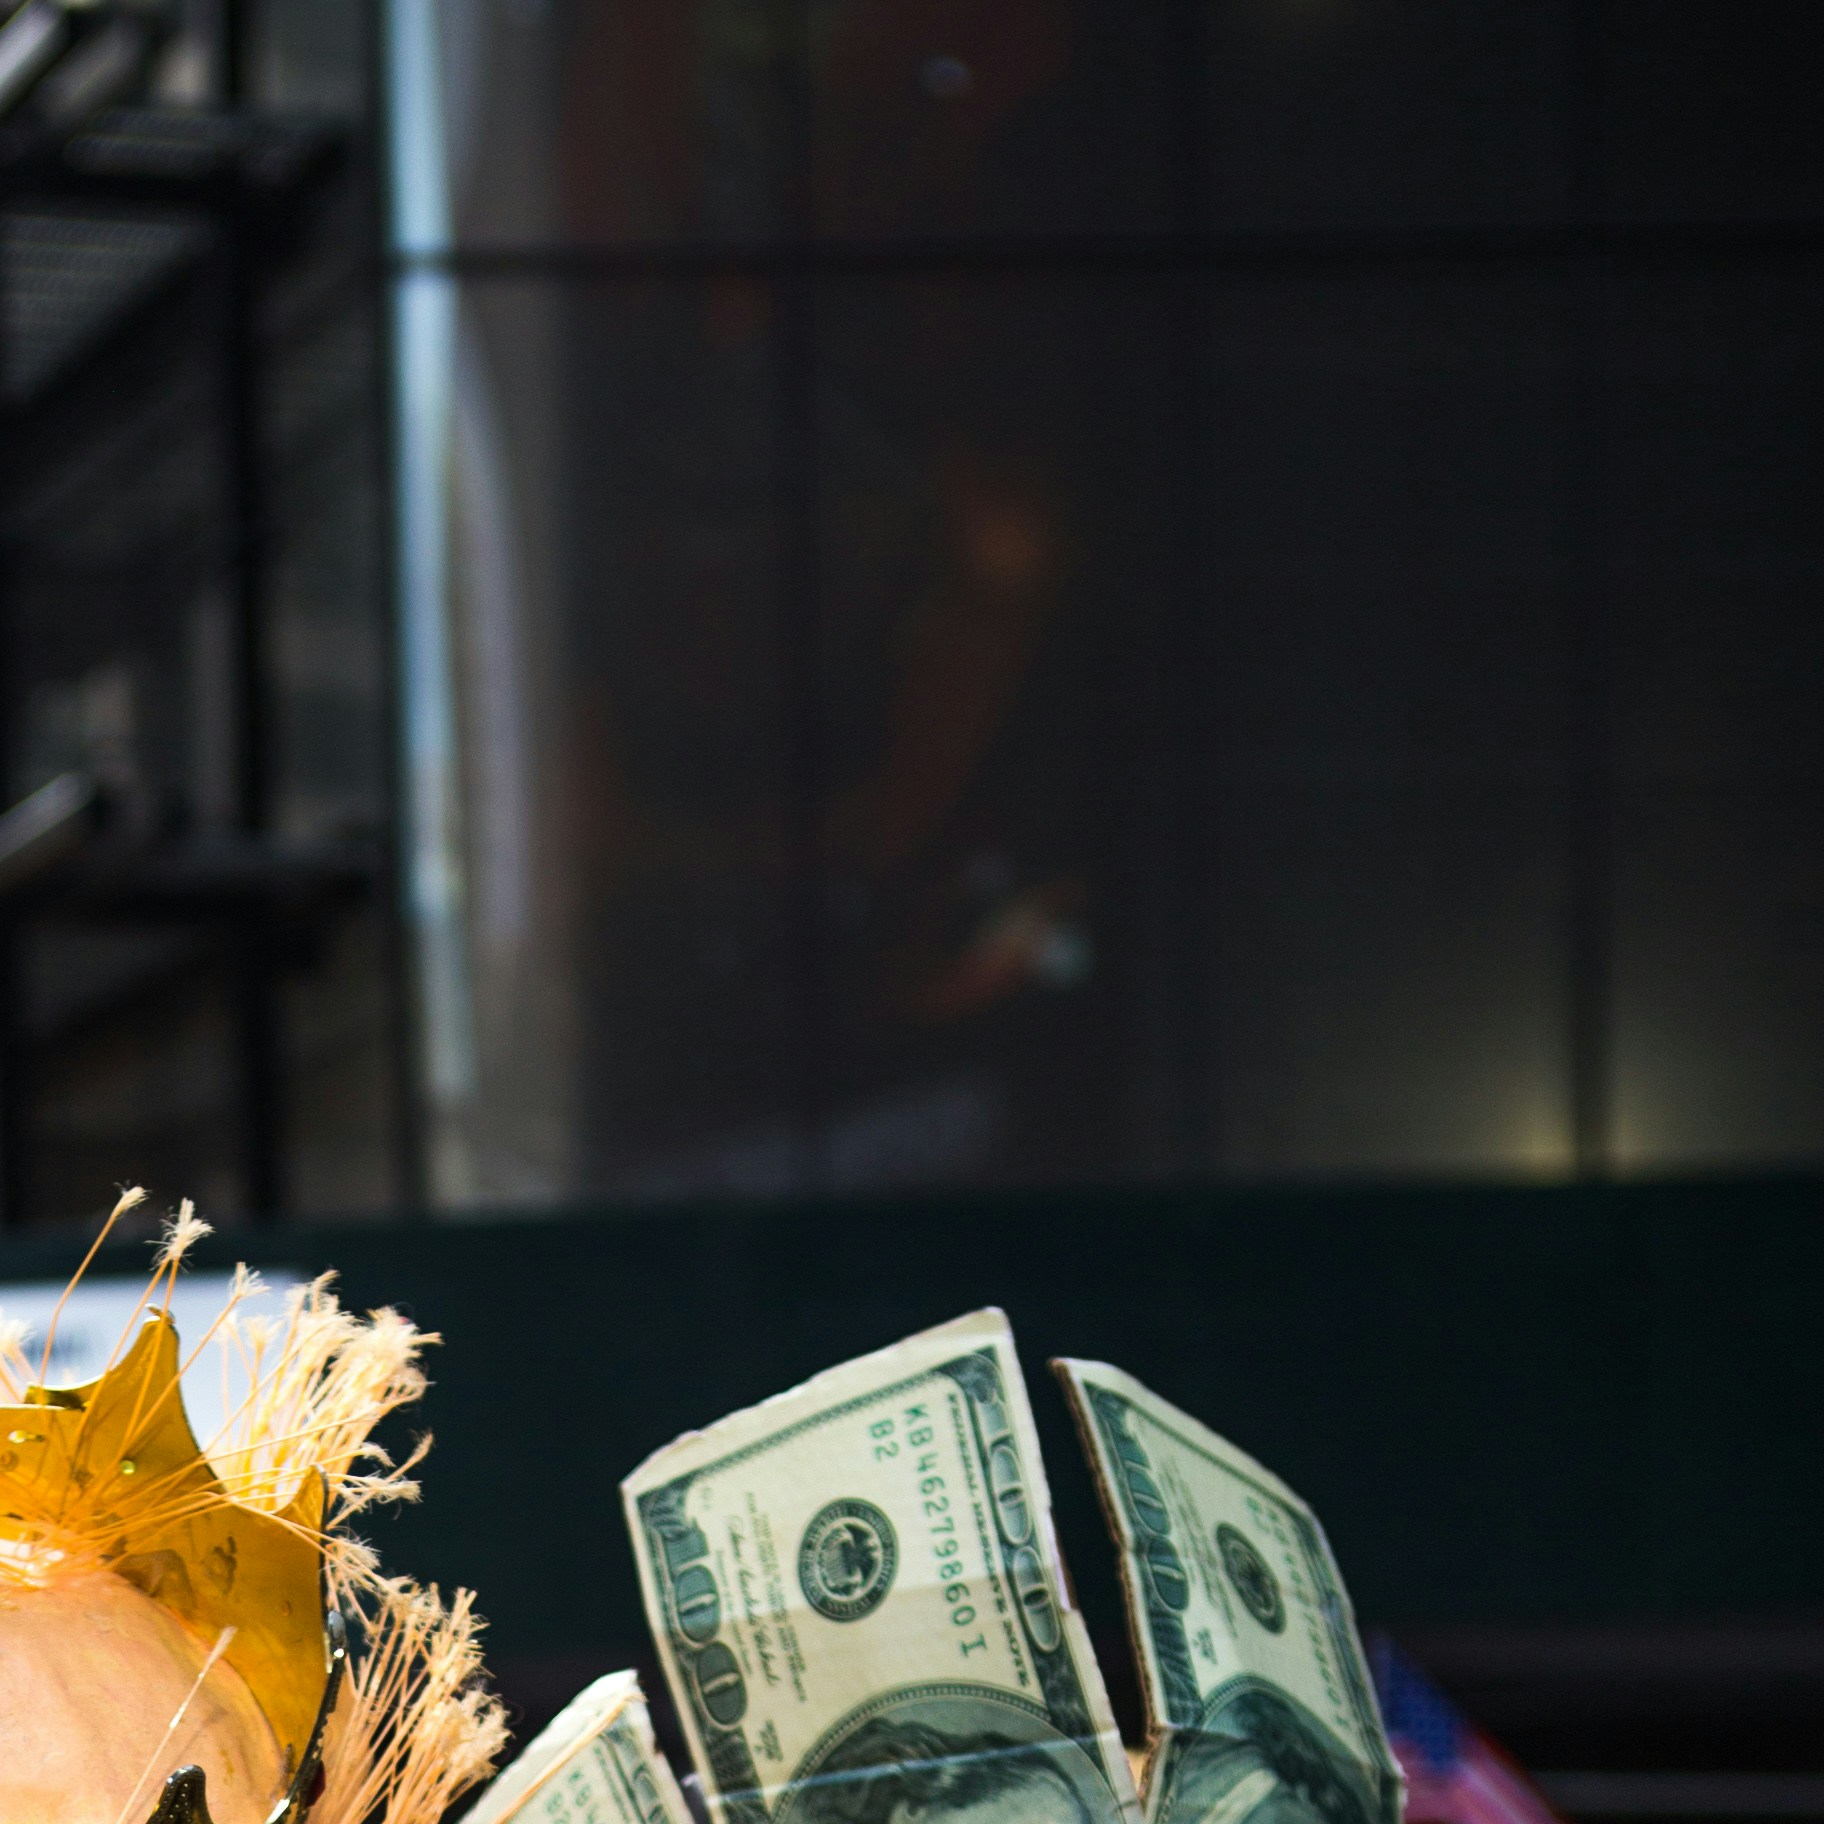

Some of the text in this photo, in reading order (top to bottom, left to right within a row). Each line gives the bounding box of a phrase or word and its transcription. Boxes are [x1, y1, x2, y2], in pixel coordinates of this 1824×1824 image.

[866, 1417, 901, 1465] B2
[900, 1402, 935, 1449] KB
[911, 1450, 979, 1629] 46279860
[965, 1386, 1067, 1658] 100
[655, 1516, 756, 1734] 100
